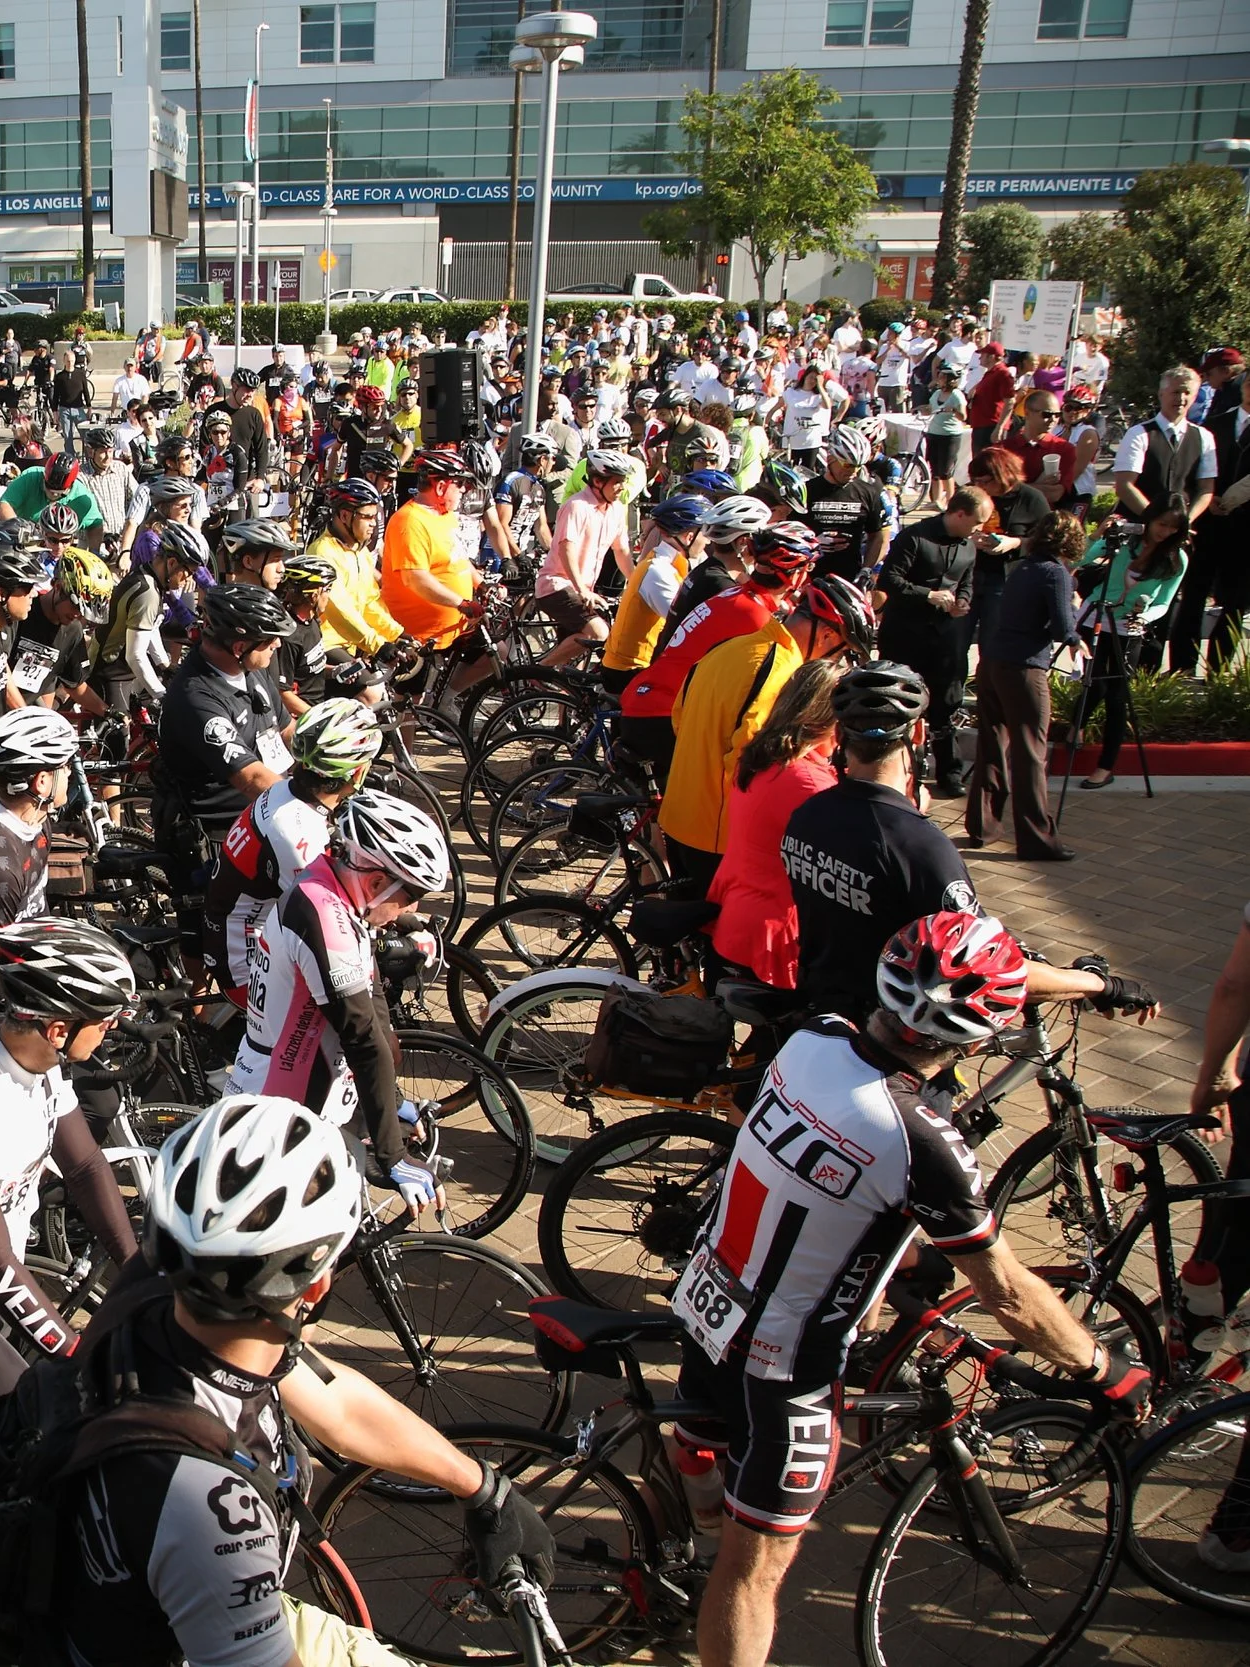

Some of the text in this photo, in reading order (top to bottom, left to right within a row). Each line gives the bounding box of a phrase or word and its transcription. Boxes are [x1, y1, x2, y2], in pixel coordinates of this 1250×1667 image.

[1000, 178, 1111, 192] PERMANENTE
[5, 198, 30, 211] LOS
[363, 188, 390, 200] FOR
[394, 187, 406, 200] A
[408, 185, 509, 200] WORLD-CLASS
[212, 268, 232, 277] STAY
[813, 514, 859, 522] Mercedes-Benz
[22, 665, 42, 680] 421
[817, 851, 875, 890] SAFETY
[685, 1271, 733, 1330] 168
[820, 1253, 881, 1325] VELO
[210, 1369, 254, 1392] ANTERA
[778, 1382, 833, 1494] VELO
[213, 1535, 276, 1556] GRIP SHIFT
